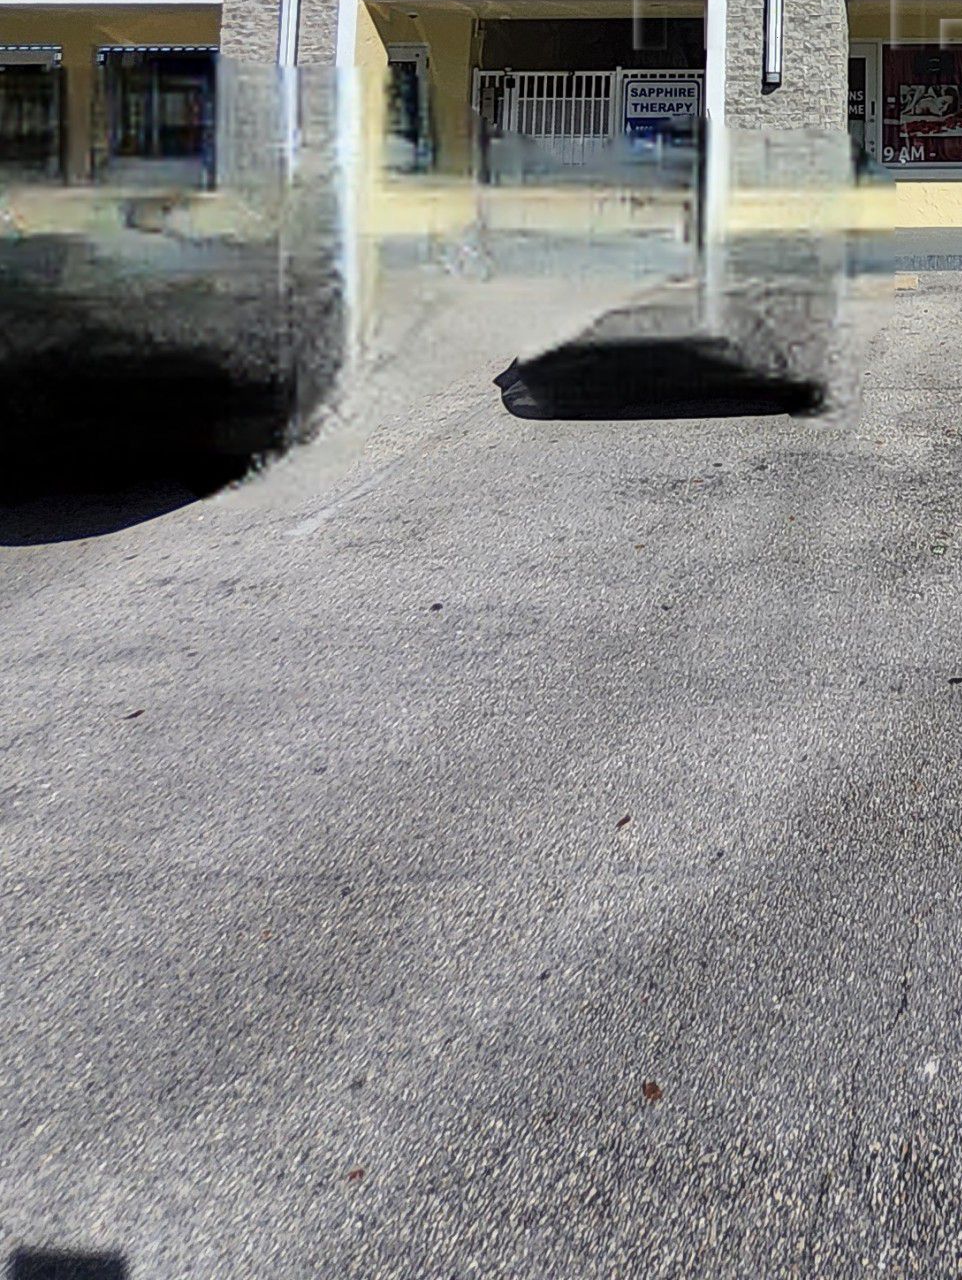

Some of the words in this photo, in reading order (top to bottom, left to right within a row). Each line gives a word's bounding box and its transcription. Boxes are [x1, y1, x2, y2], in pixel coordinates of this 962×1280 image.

[630, 87, 695, 98] SAPPHIRE
[631, 103, 693, 113] THERAPY
[883, 146, 894, 161] 9
[899, 146, 925, 161] AM
